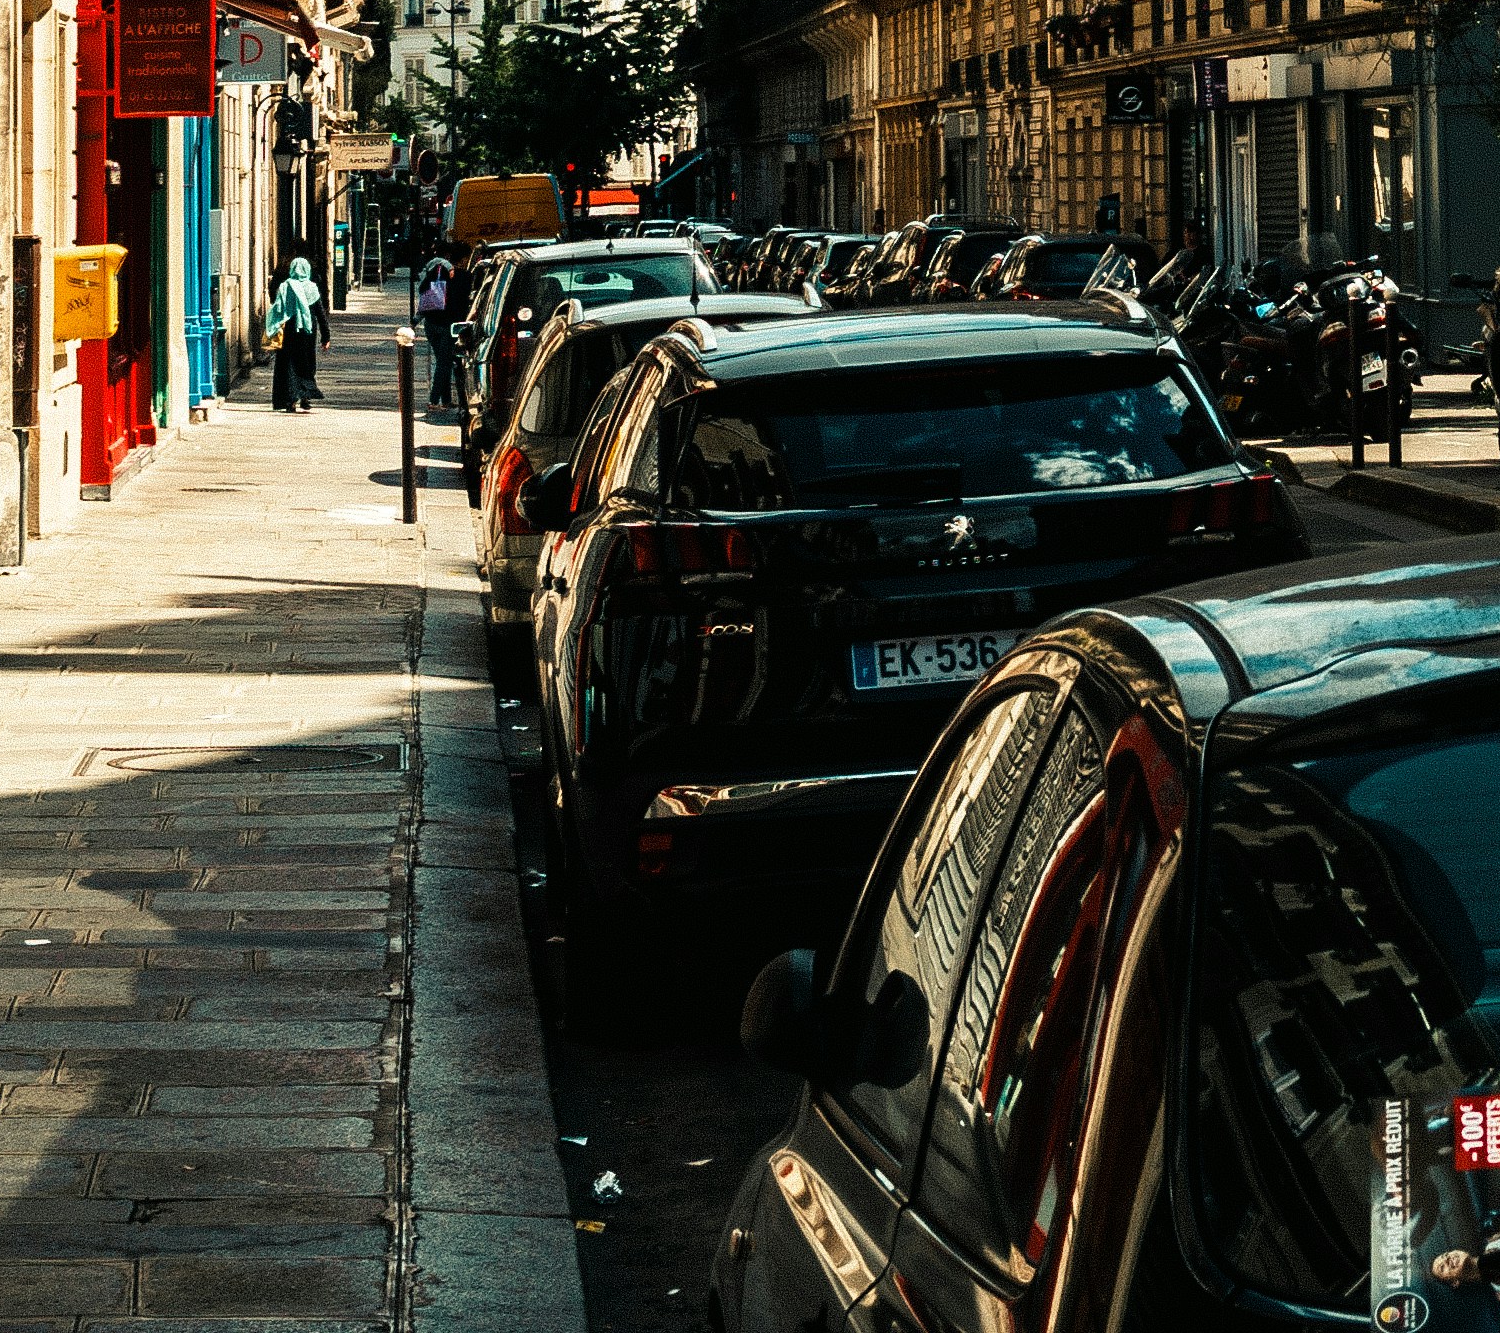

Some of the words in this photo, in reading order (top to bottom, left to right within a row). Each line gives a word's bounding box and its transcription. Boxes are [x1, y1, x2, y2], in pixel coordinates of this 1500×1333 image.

[137, 23, 201, 36] L'AFFICHE
[239, 33, 263, 67] D
[918, 554, 1008, 566] PEUGEOT
[878, 634, 1026, 680] EK-536
[1383, 1100, 1403, 1153] RÉDUIT
[1386, 1158, 1403, 1193] PRIX
[1386, 1211, 1404, 1267] FORME
[1387, 1271, 1404, 1289] LA
